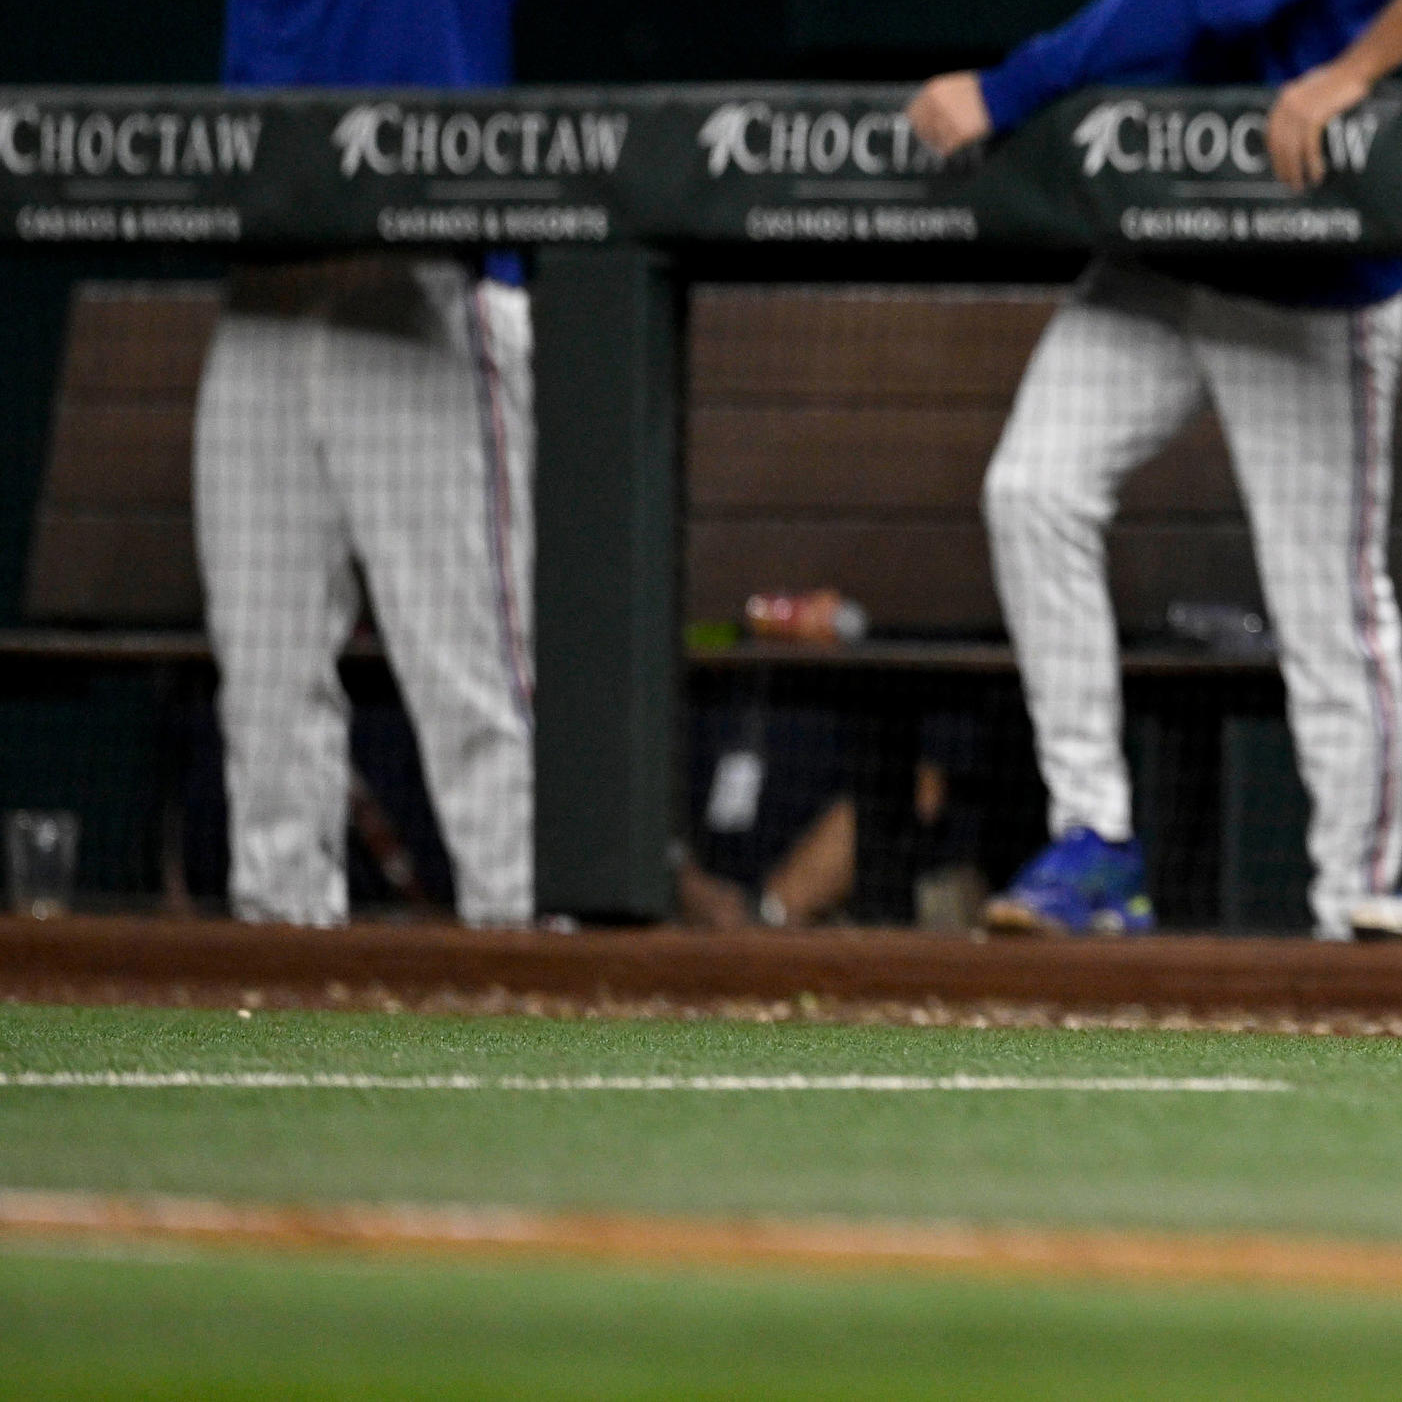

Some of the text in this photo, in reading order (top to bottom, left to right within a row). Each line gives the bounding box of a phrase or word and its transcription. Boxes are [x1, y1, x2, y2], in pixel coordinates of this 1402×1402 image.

[0, 103, 263, 176] CHOCTAW
[365, 101, 629, 176] CHOCTAW
[735, 100, 980, 175] CHOCT
[1105, 100, 1379, 175] CHOCW
